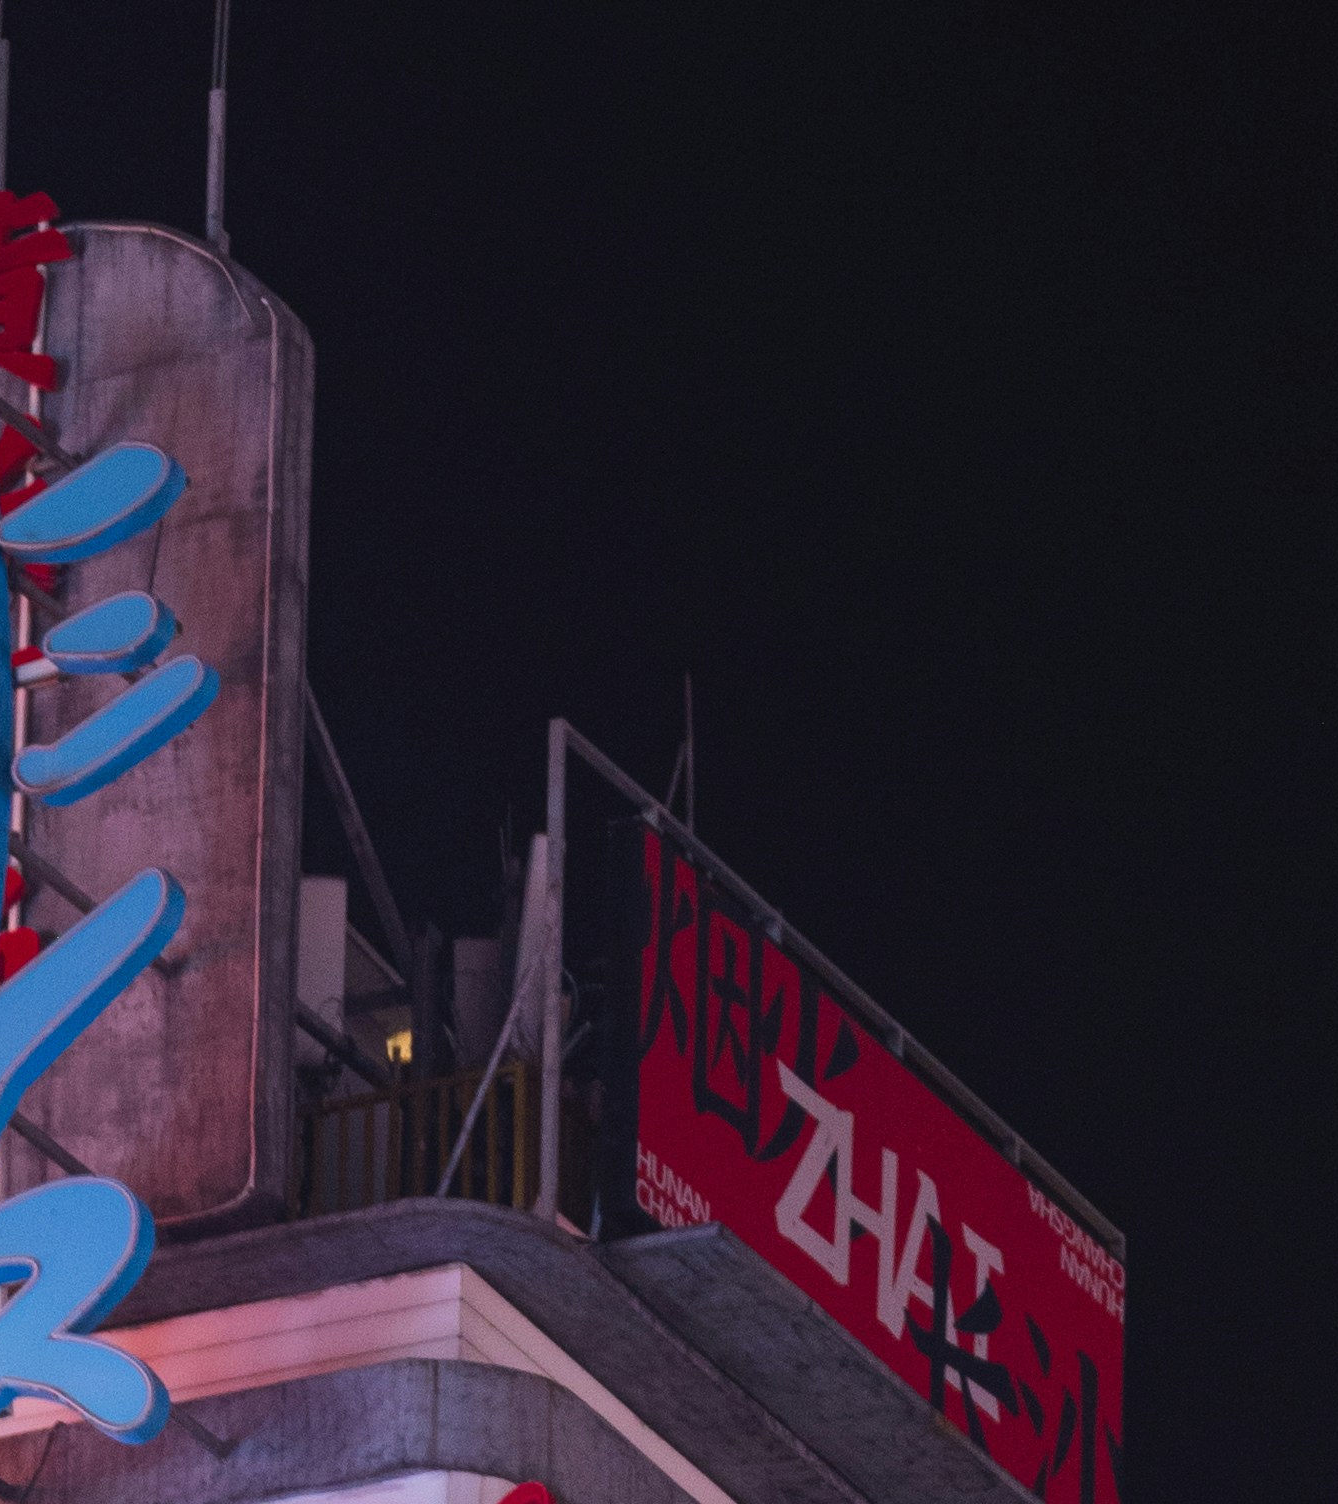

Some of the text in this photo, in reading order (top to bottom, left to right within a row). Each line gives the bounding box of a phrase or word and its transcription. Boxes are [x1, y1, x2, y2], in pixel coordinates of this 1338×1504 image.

[777, 1058, 1005, 1423] ZHAI
[1027, 1178, 1125, 1287] CHANGSHA
[1060, 1243, 1125, 1319] HUNAN
